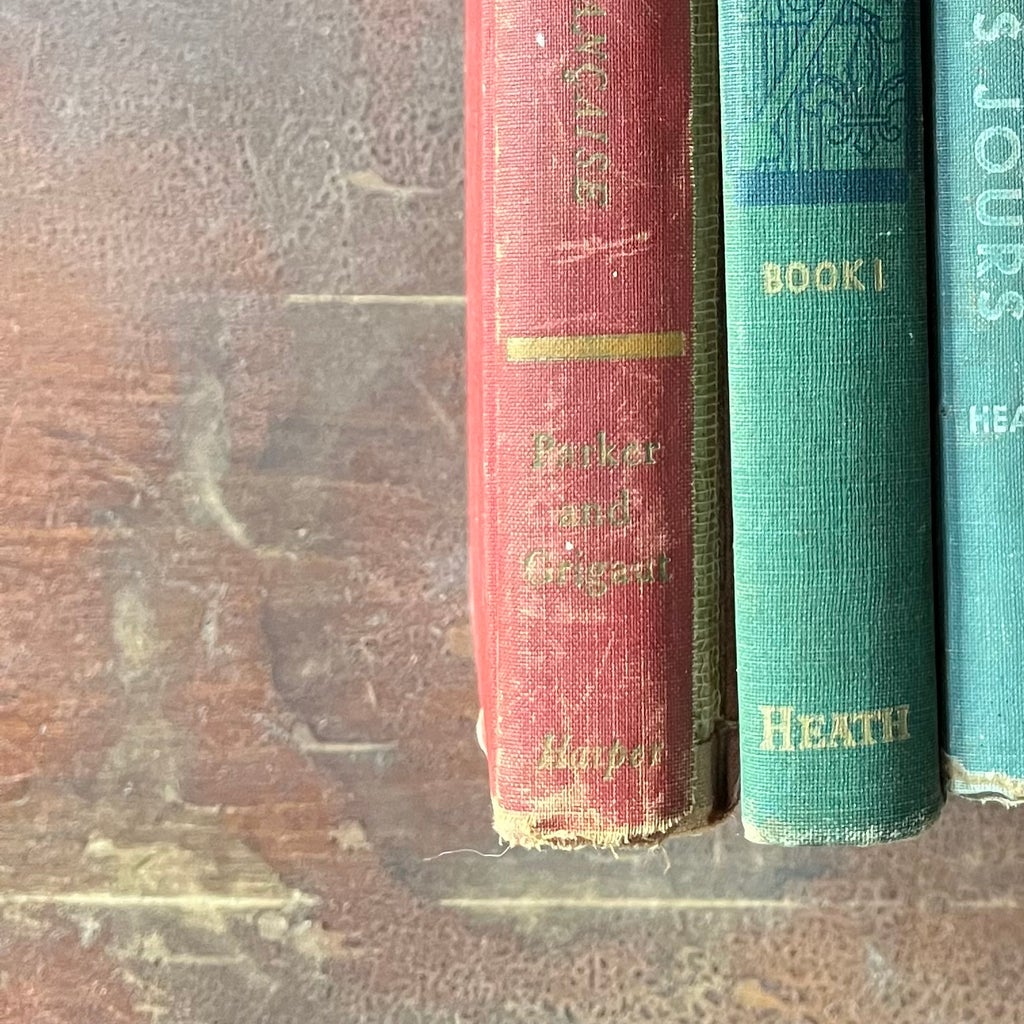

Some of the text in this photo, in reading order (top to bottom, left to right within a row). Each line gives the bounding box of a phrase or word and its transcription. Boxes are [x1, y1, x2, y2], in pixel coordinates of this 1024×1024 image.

[973, 82, 1024, 322] JOURS
[762, 257, 866, 296] BOOK
[529, 431, 662, 471] Parker
[557, 487, 633, 529] and
[757, 704, 912, 752] HEATH
[536, 731, 667, 782] Harper
